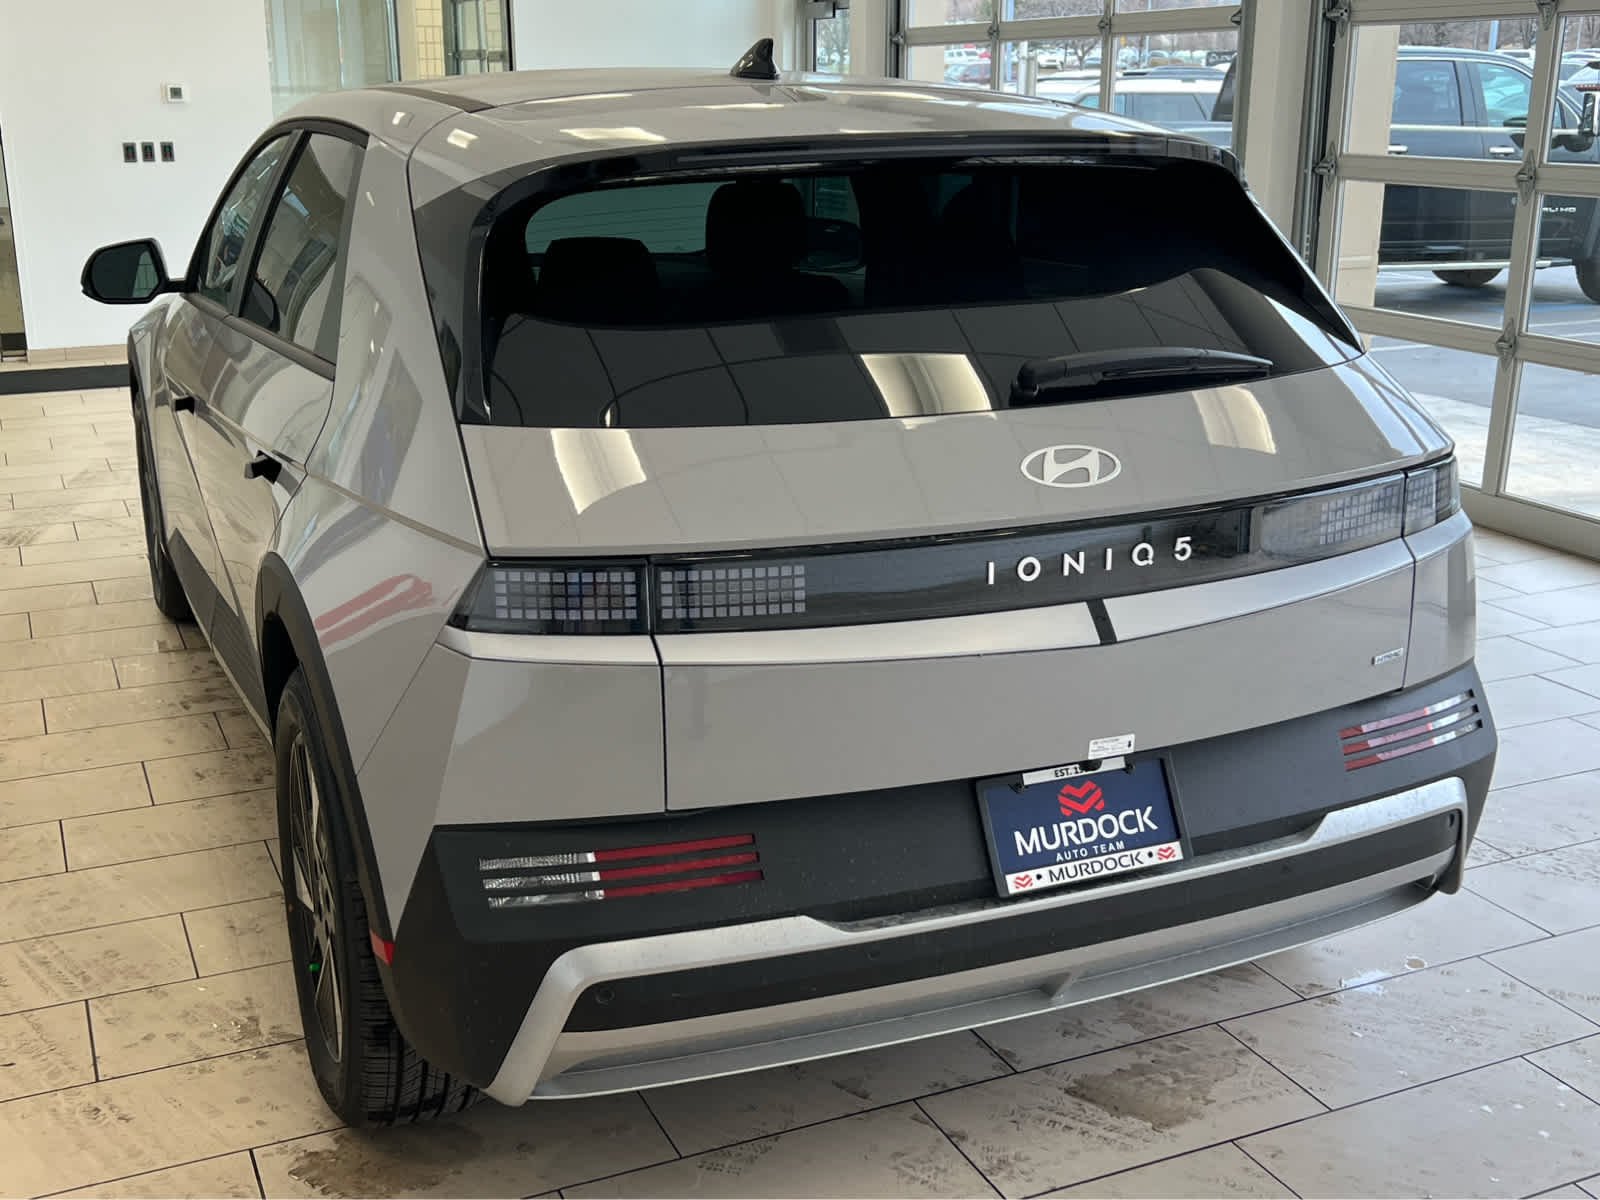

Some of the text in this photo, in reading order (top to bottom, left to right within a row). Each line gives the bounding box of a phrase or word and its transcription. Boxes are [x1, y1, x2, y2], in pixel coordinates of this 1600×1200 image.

[987, 536, 1192, 585] IONIQ 5
[1054, 768, 1073, 778] EST.
[1014, 806, 1158, 856] MURDOCK
[1048, 851, 1145, 883] MURDOCK
[1056, 840, 1126, 862] AUTO TEAM
